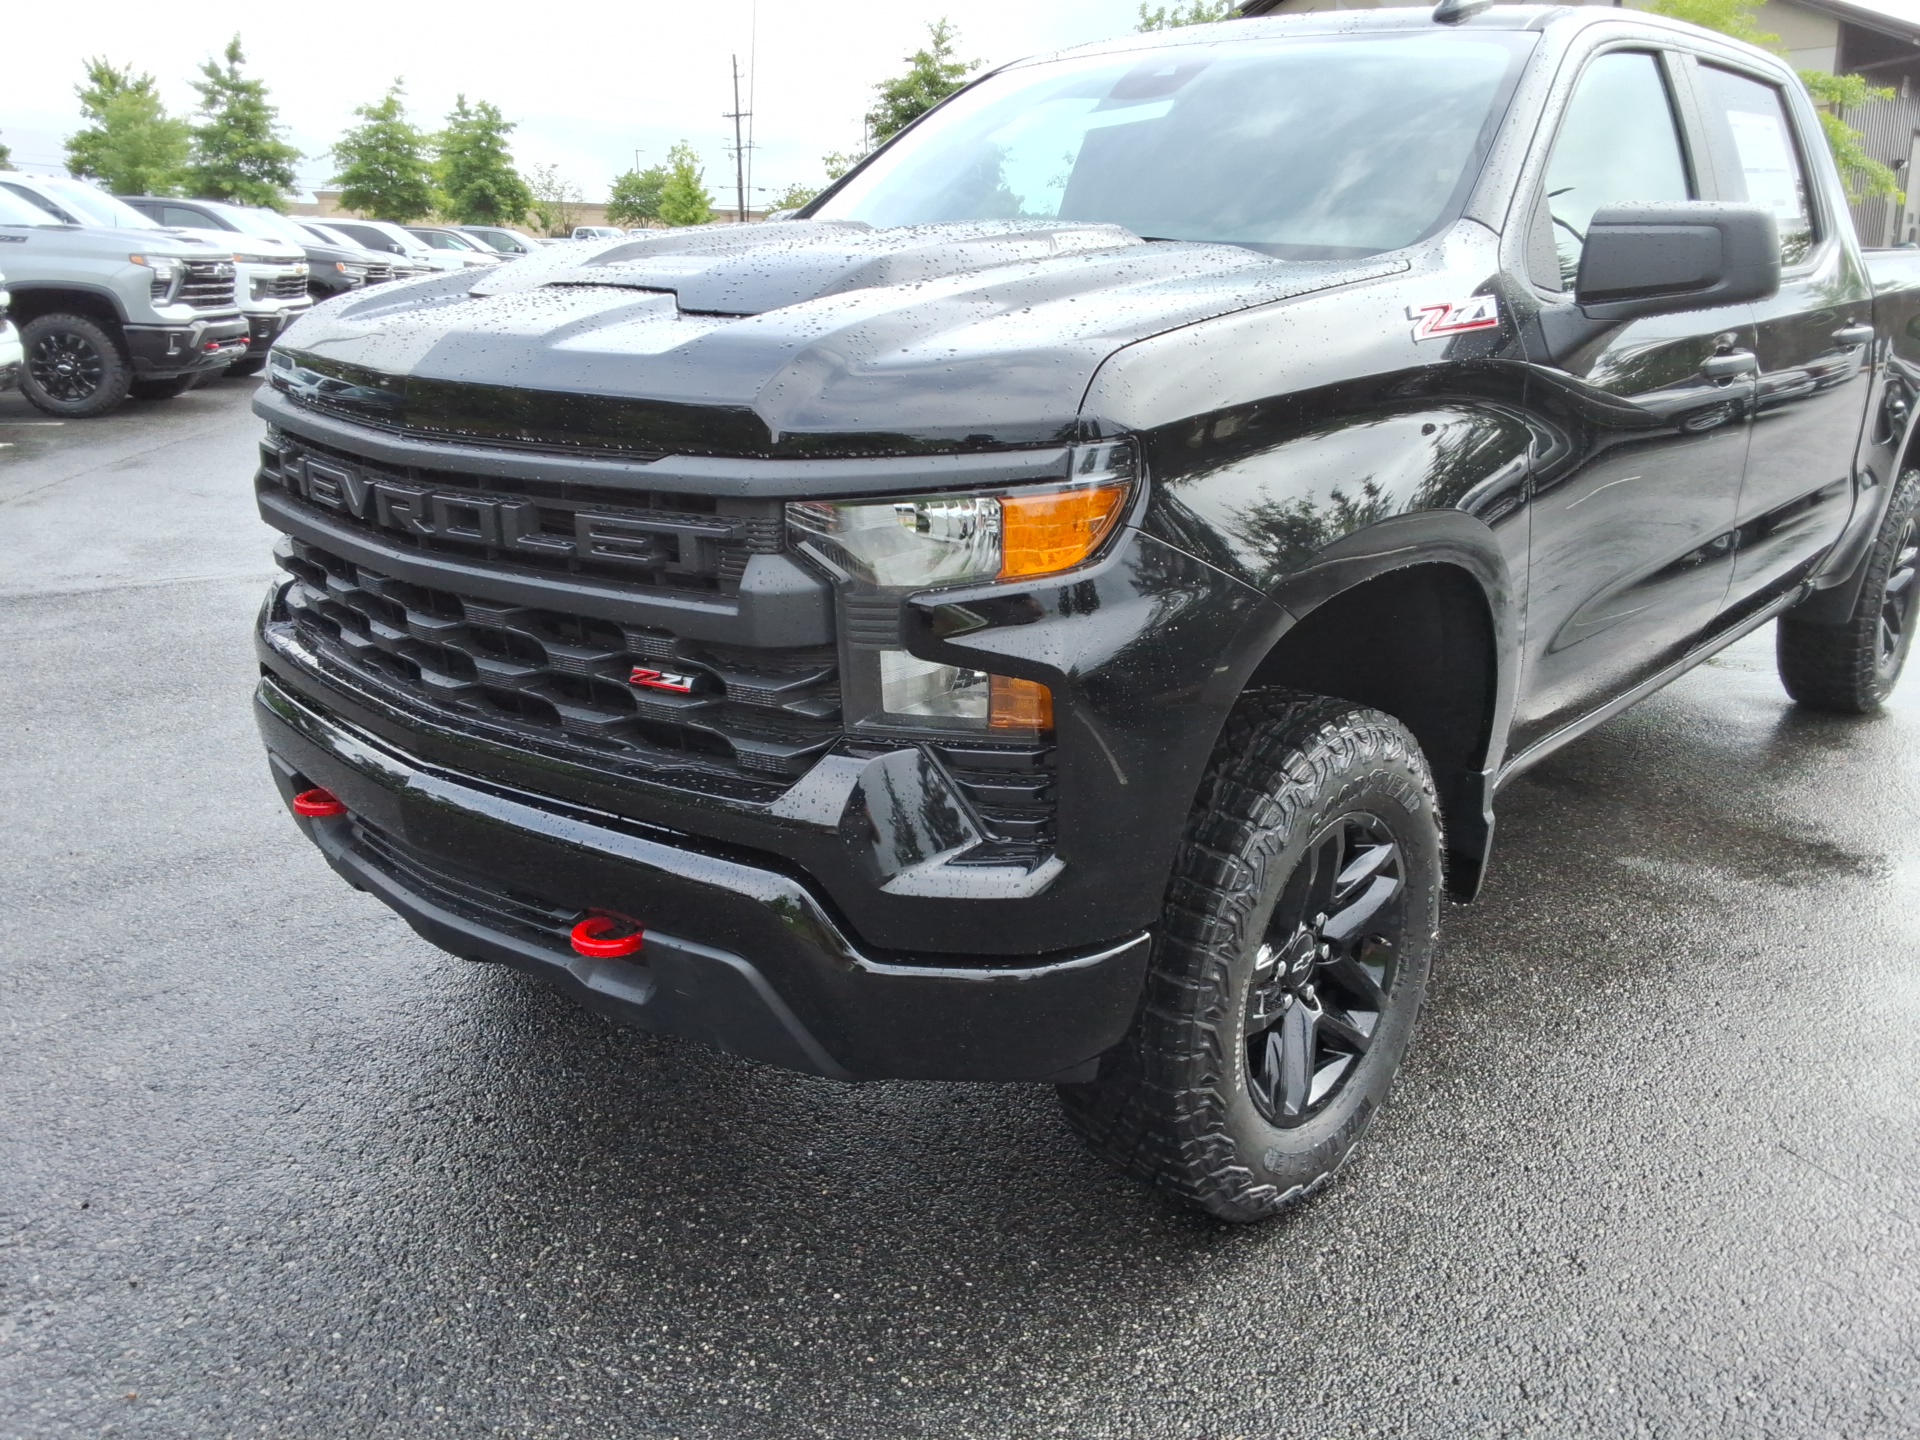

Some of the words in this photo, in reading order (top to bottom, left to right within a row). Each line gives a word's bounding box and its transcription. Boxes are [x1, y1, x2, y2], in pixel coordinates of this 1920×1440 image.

[1405, 295, 1499, 343] Z71
[258, 440, 744, 576] CHEVROLET
[629, 666, 695, 693] Z71
[1307, 768, 1421, 839] GOODYEAR
